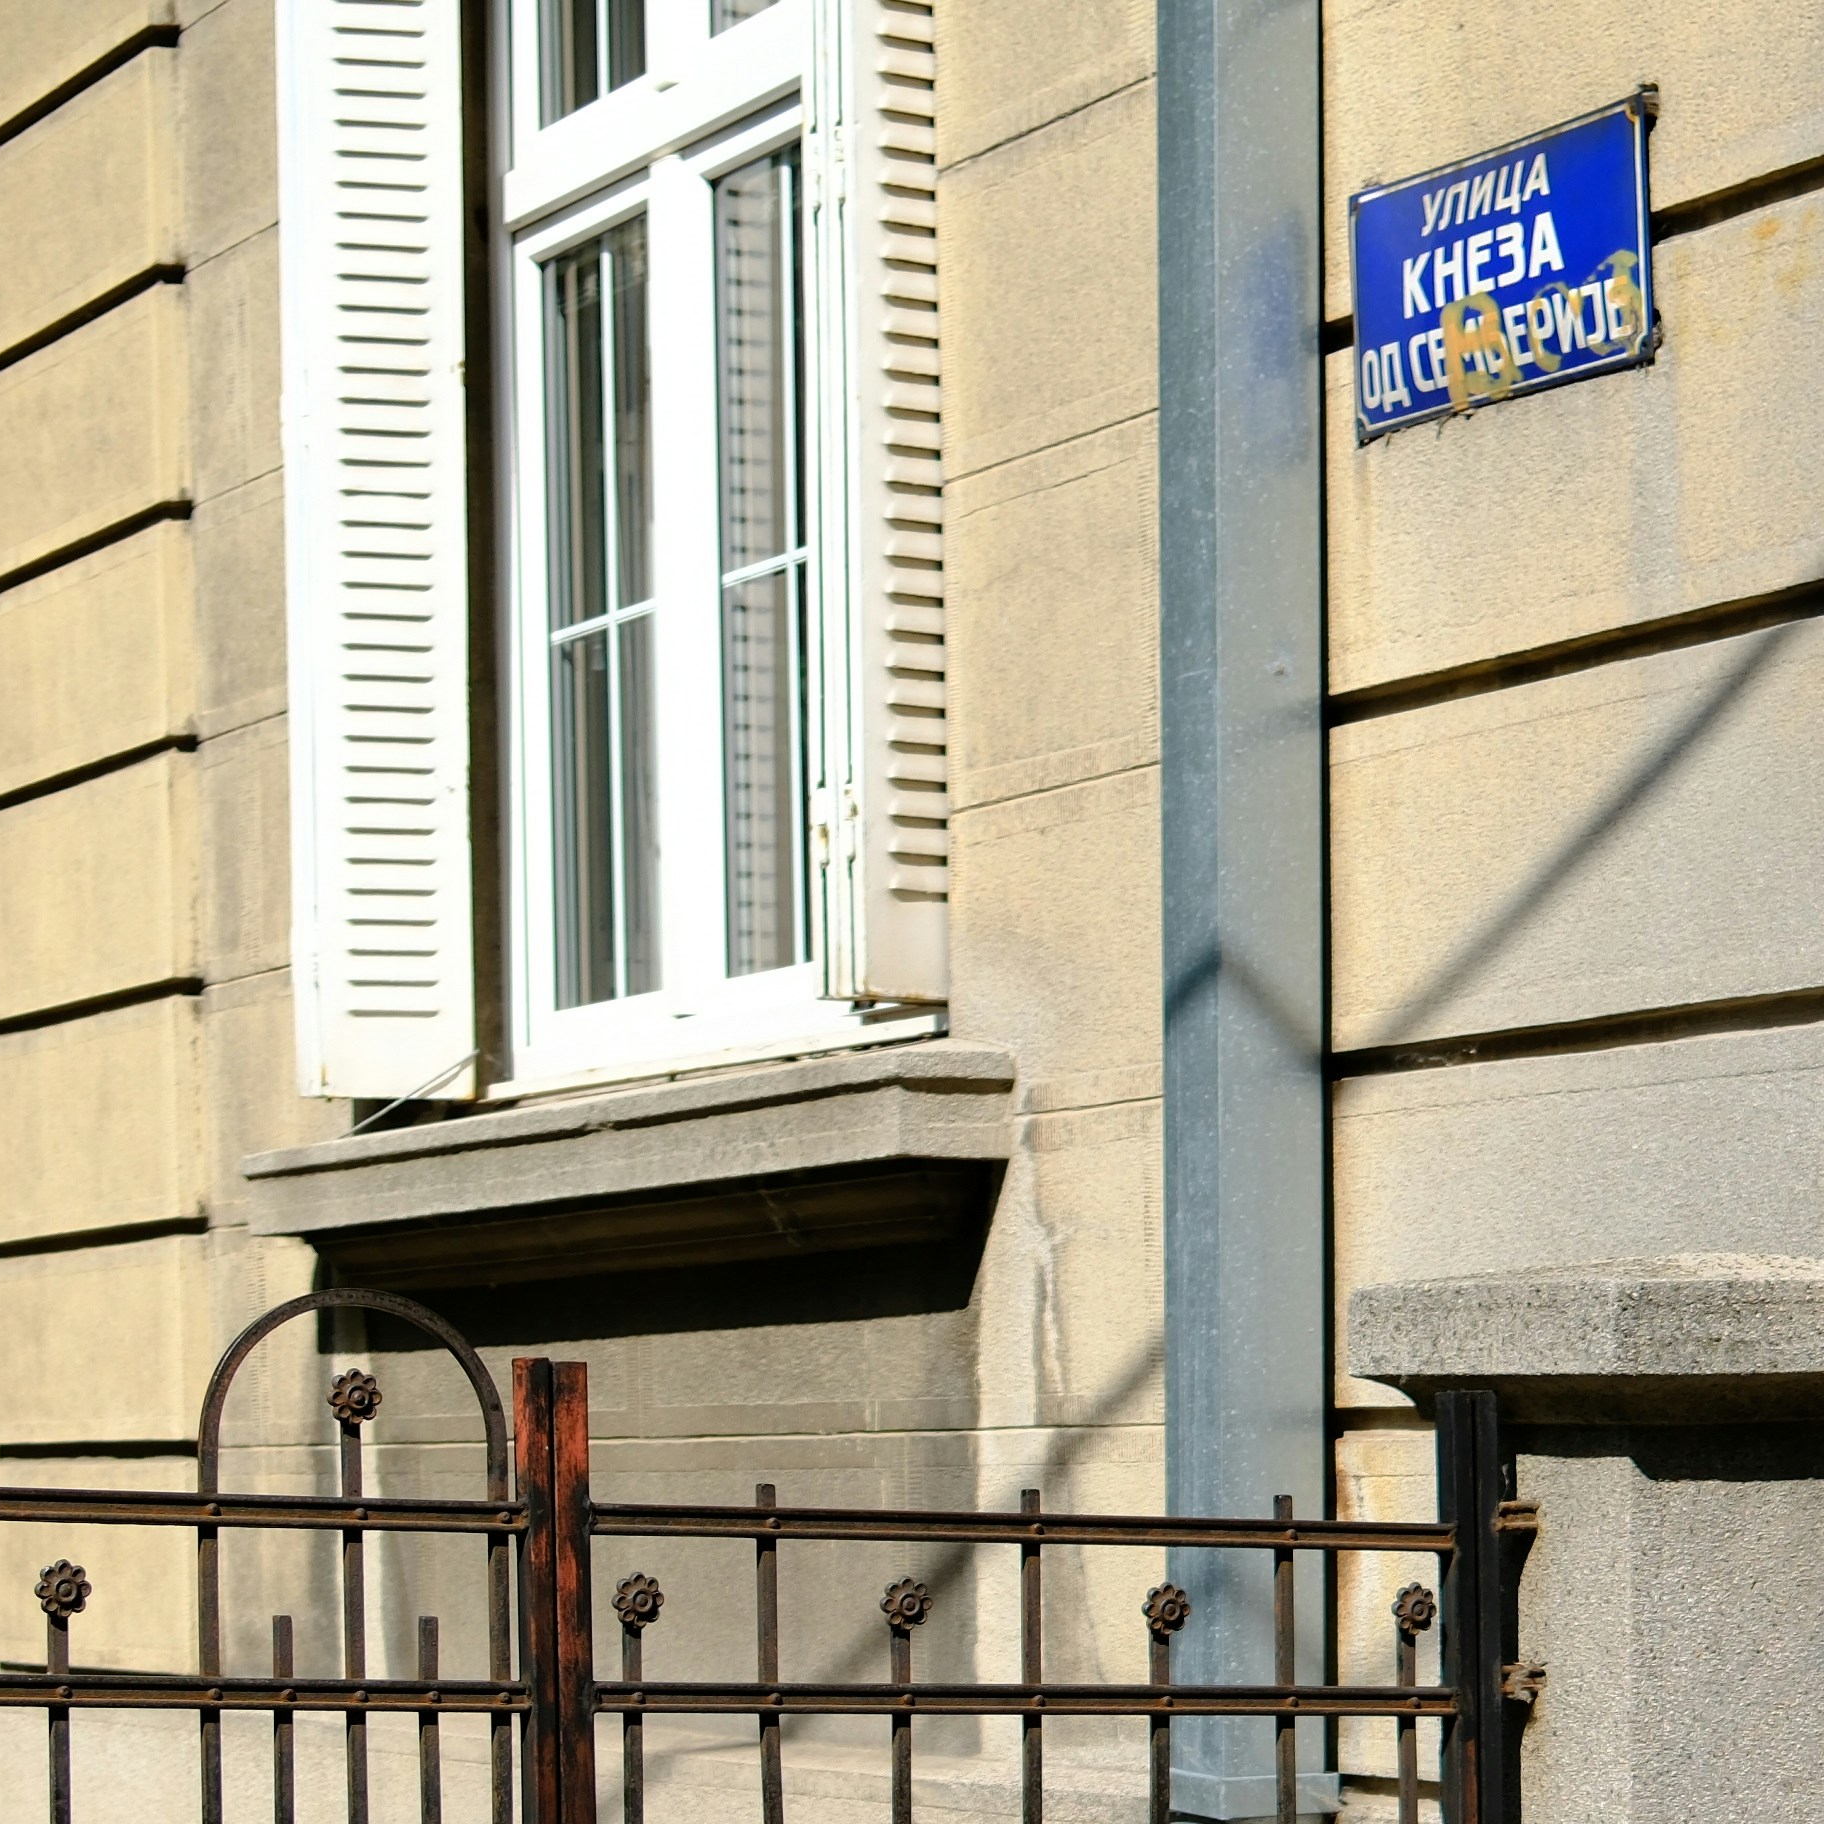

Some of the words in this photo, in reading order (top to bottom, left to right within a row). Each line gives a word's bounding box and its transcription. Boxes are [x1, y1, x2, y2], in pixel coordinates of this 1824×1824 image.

[1421, 152, 1551, 237] УЛИЦА
[1402, 211, 1565, 320] КНЕЗА
[1362, 341, 1412, 412] ОД
